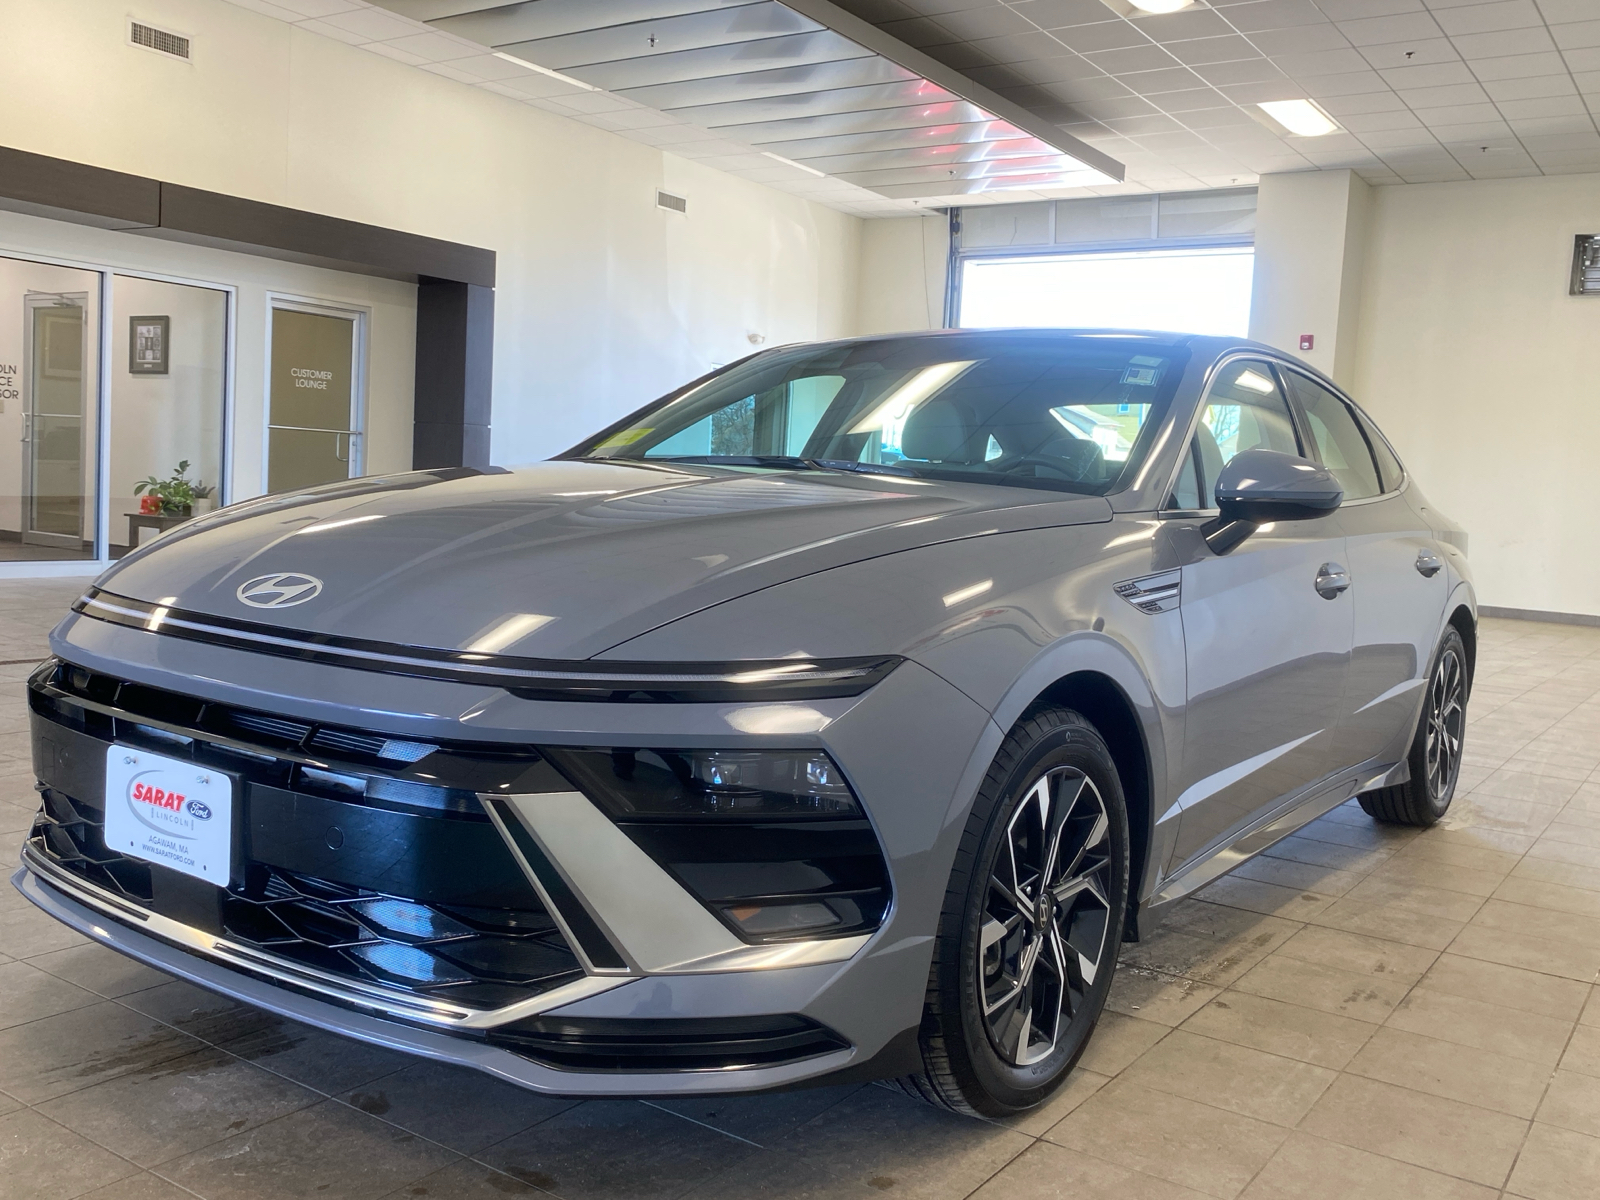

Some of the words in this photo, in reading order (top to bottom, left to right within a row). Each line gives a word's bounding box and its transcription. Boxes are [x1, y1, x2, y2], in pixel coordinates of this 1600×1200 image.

[290, 367, 333, 380] CUSTOMER
[295, 378, 328, 390] LOUNGE
[132, 782, 186, 813] SARAT
[189, 801, 209, 818] Ford
[156, 811, 189, 828] LINCOLN
[148, 835, 178, 852] AGAWAM,
[178, 844, 189, 855] MA
[142, 843, 196, 867] WWW.SARATFORD.COM
